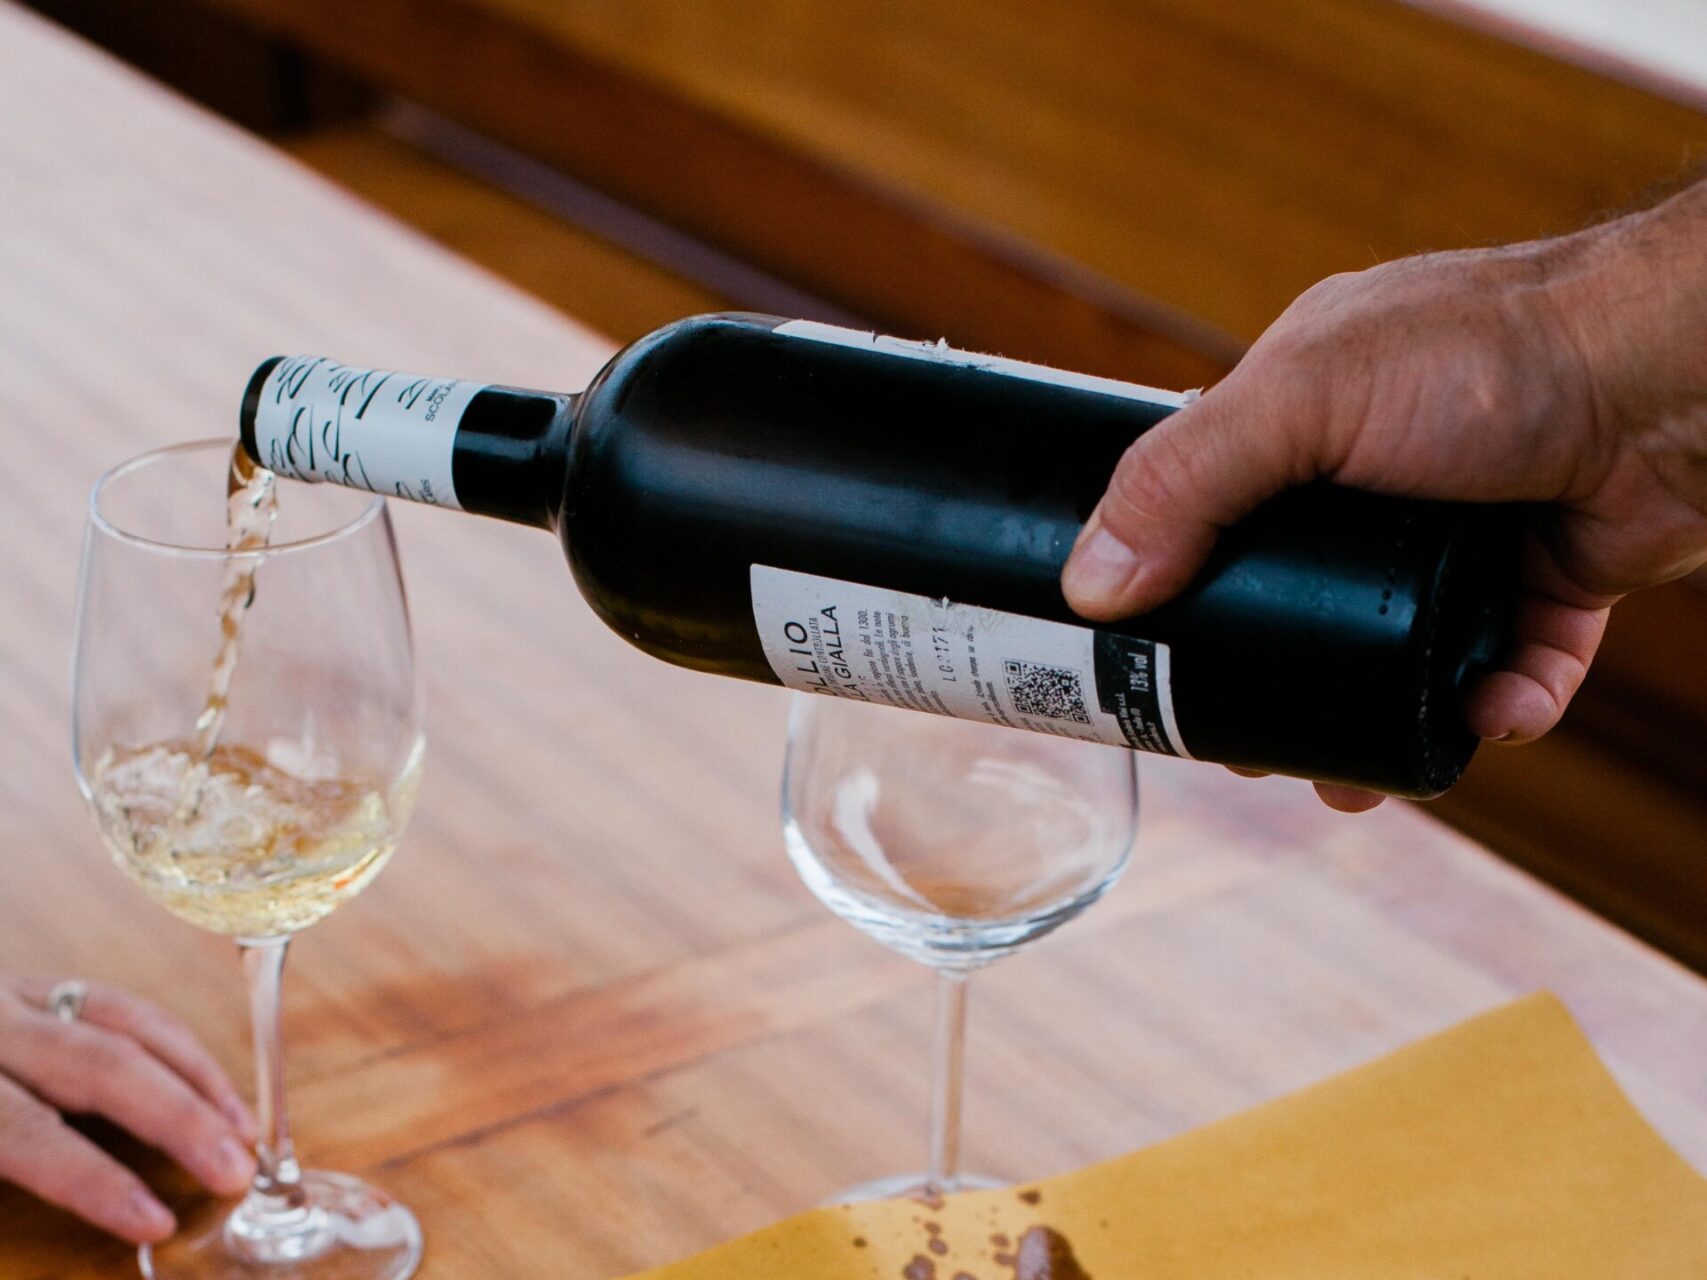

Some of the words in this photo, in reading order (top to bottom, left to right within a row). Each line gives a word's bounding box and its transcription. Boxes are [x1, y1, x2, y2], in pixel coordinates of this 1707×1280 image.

[857, 609, 869, 629] 1300.
[872, 610, 882, 627] note
[887, 612, 899, 639] agrumi
[808, 617, 828, 664] CONTROLLATA
[820, 605, 851, 679] GIALLA
[784, 621, 839, 696] OLLIO
[1127, 652, 1148, 669] vol
[1129, 671, 1148, 691] 13%
